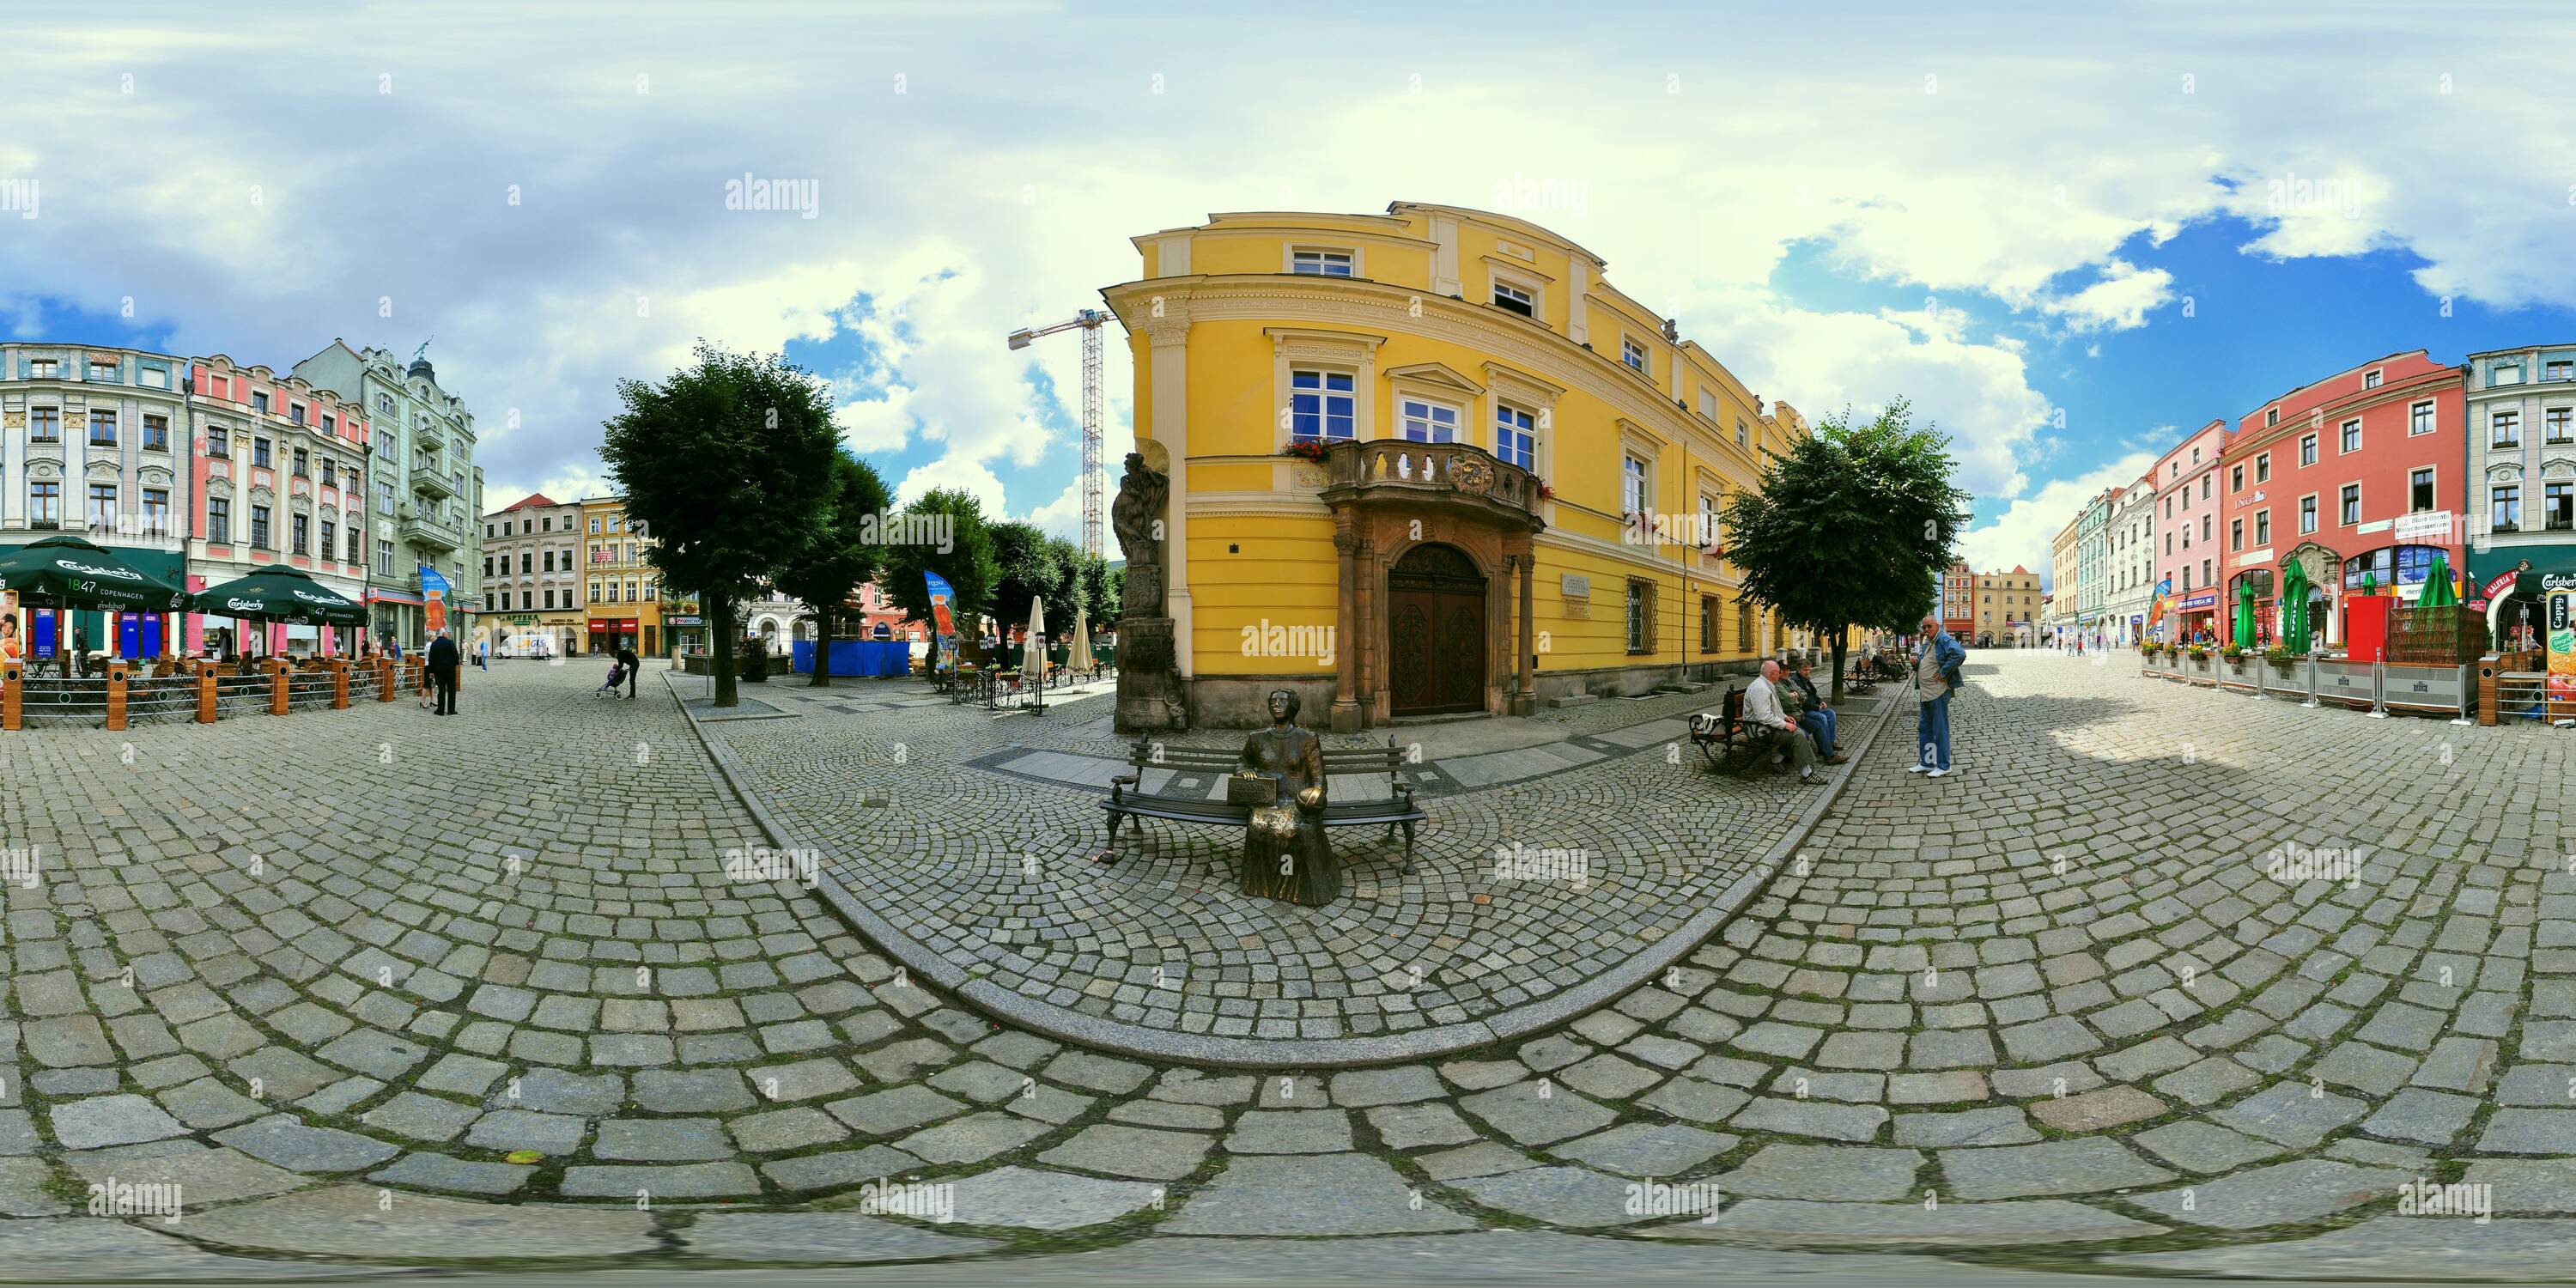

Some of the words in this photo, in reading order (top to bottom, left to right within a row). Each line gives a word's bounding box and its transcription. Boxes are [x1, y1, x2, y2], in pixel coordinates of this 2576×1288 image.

[56, 559, 143, 580] Carlsberg
[68, 578, 96, 593] 1847
[100, 588, 144, 600] COPENHAGEN
[294, 590, 350, 605] Carlsberg
[228, 598, 264, 611] Carlsberg
[307, 606, 325, 615] 1847
[2553, 596, 2564, 629] Cappy
